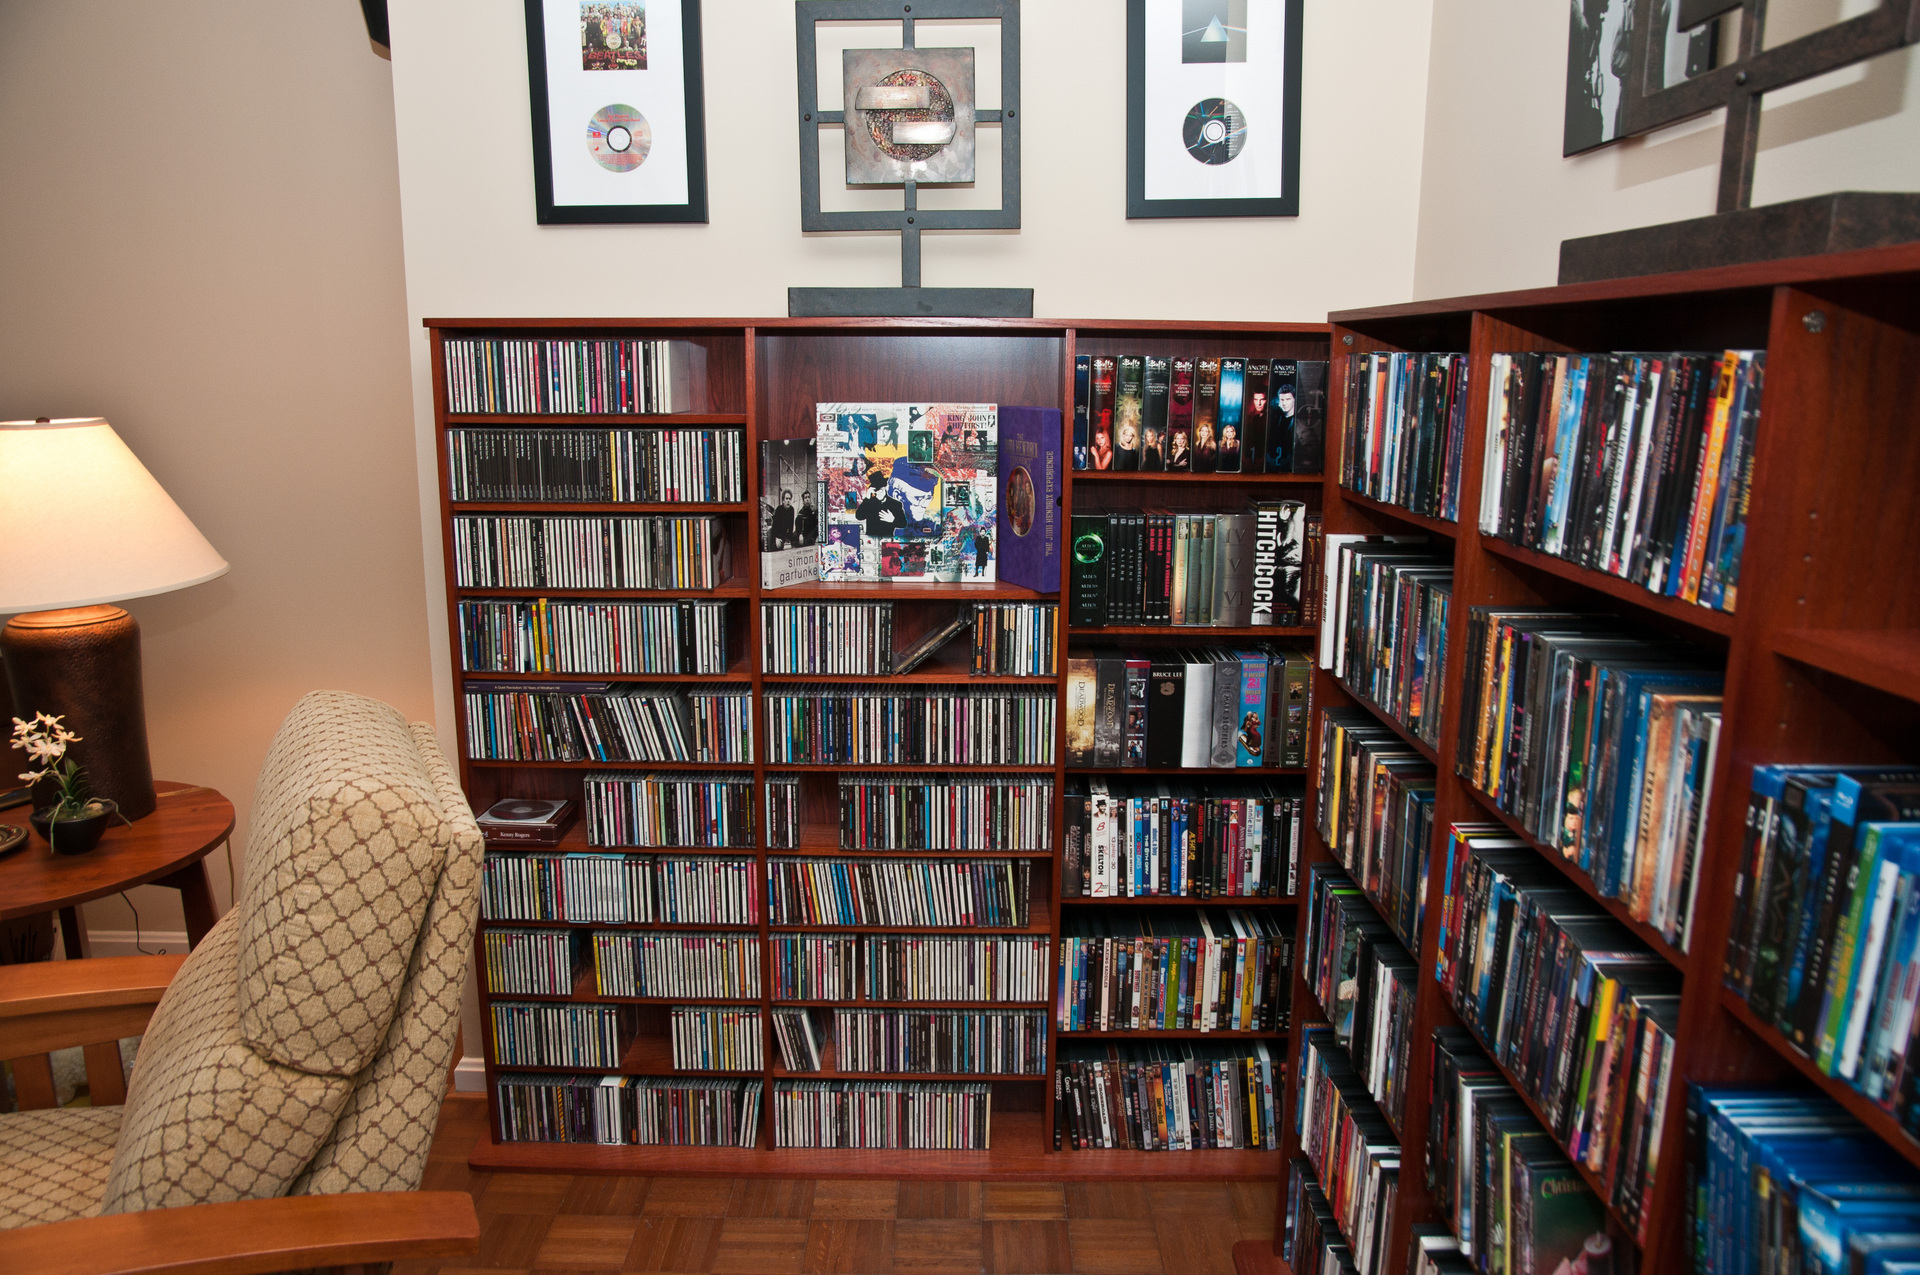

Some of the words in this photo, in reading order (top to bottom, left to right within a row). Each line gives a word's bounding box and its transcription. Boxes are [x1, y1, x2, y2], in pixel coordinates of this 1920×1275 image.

[588, 51, 641, 59] BEATLES
[1093, 359, 1114, 371] Buffy
[1122, 359, 1140, 371] Buffy
[1148, 360, 1166, 373] Buffy
[1174, 360, 1193, 372] Buffy
[1200, 361, 1217, 373] Buffy
[1223, 361, 1242, 372] Buffy
[1599, 423, 1607, 448] SIN
[1613, 421, 1630, 472] SLEEPLESS
[1660, 415, 1675, 476] COWBOYS
[1275, 446, 1282, 465] 2
[1595, 449, 1604, 478] CITY
[1045, 451, 1053, 493] EXPERIENCE
[1045, 498, 1053, 526] HENDRIX
[1604, 491, 1619, 534] SEATTLE
[1739, 487, 1751, 516] TREK
[1045, 528, 1053, 541] JIMI
[1045, 543, 1053, 556] THE
[1251, 511, 1278, 613] HITCHCOCK
[779, 566, 818, 586] garfunke
[1077, 681, 1086, 727] DEADWOOD
[1108, 683, 1116, 729] DEADWOOD
[1222, 695, 1230, 714] MARX
[1221, 717, 1229, 748] BROTHERS
[1507, 703, 1516, 753] TERMINATOR
[1641, 770, 1656, 843] TOMBSTONE
[1111, 861, 1116, 869] 30
[1457, 900, 1469, 959] TRAFFIC
[1791, 908, 1813, 969] AVATAR
[1469, 926, 1478, 965] TUXEDO
[1642, 1031, 1653, 1053] WILD
[1640, 1052, 1650, 1075] WILD
[1098, 1083, 1107, 1125] CROSSROADS
[1206, 1089, 1214, 1111] DONNIE
